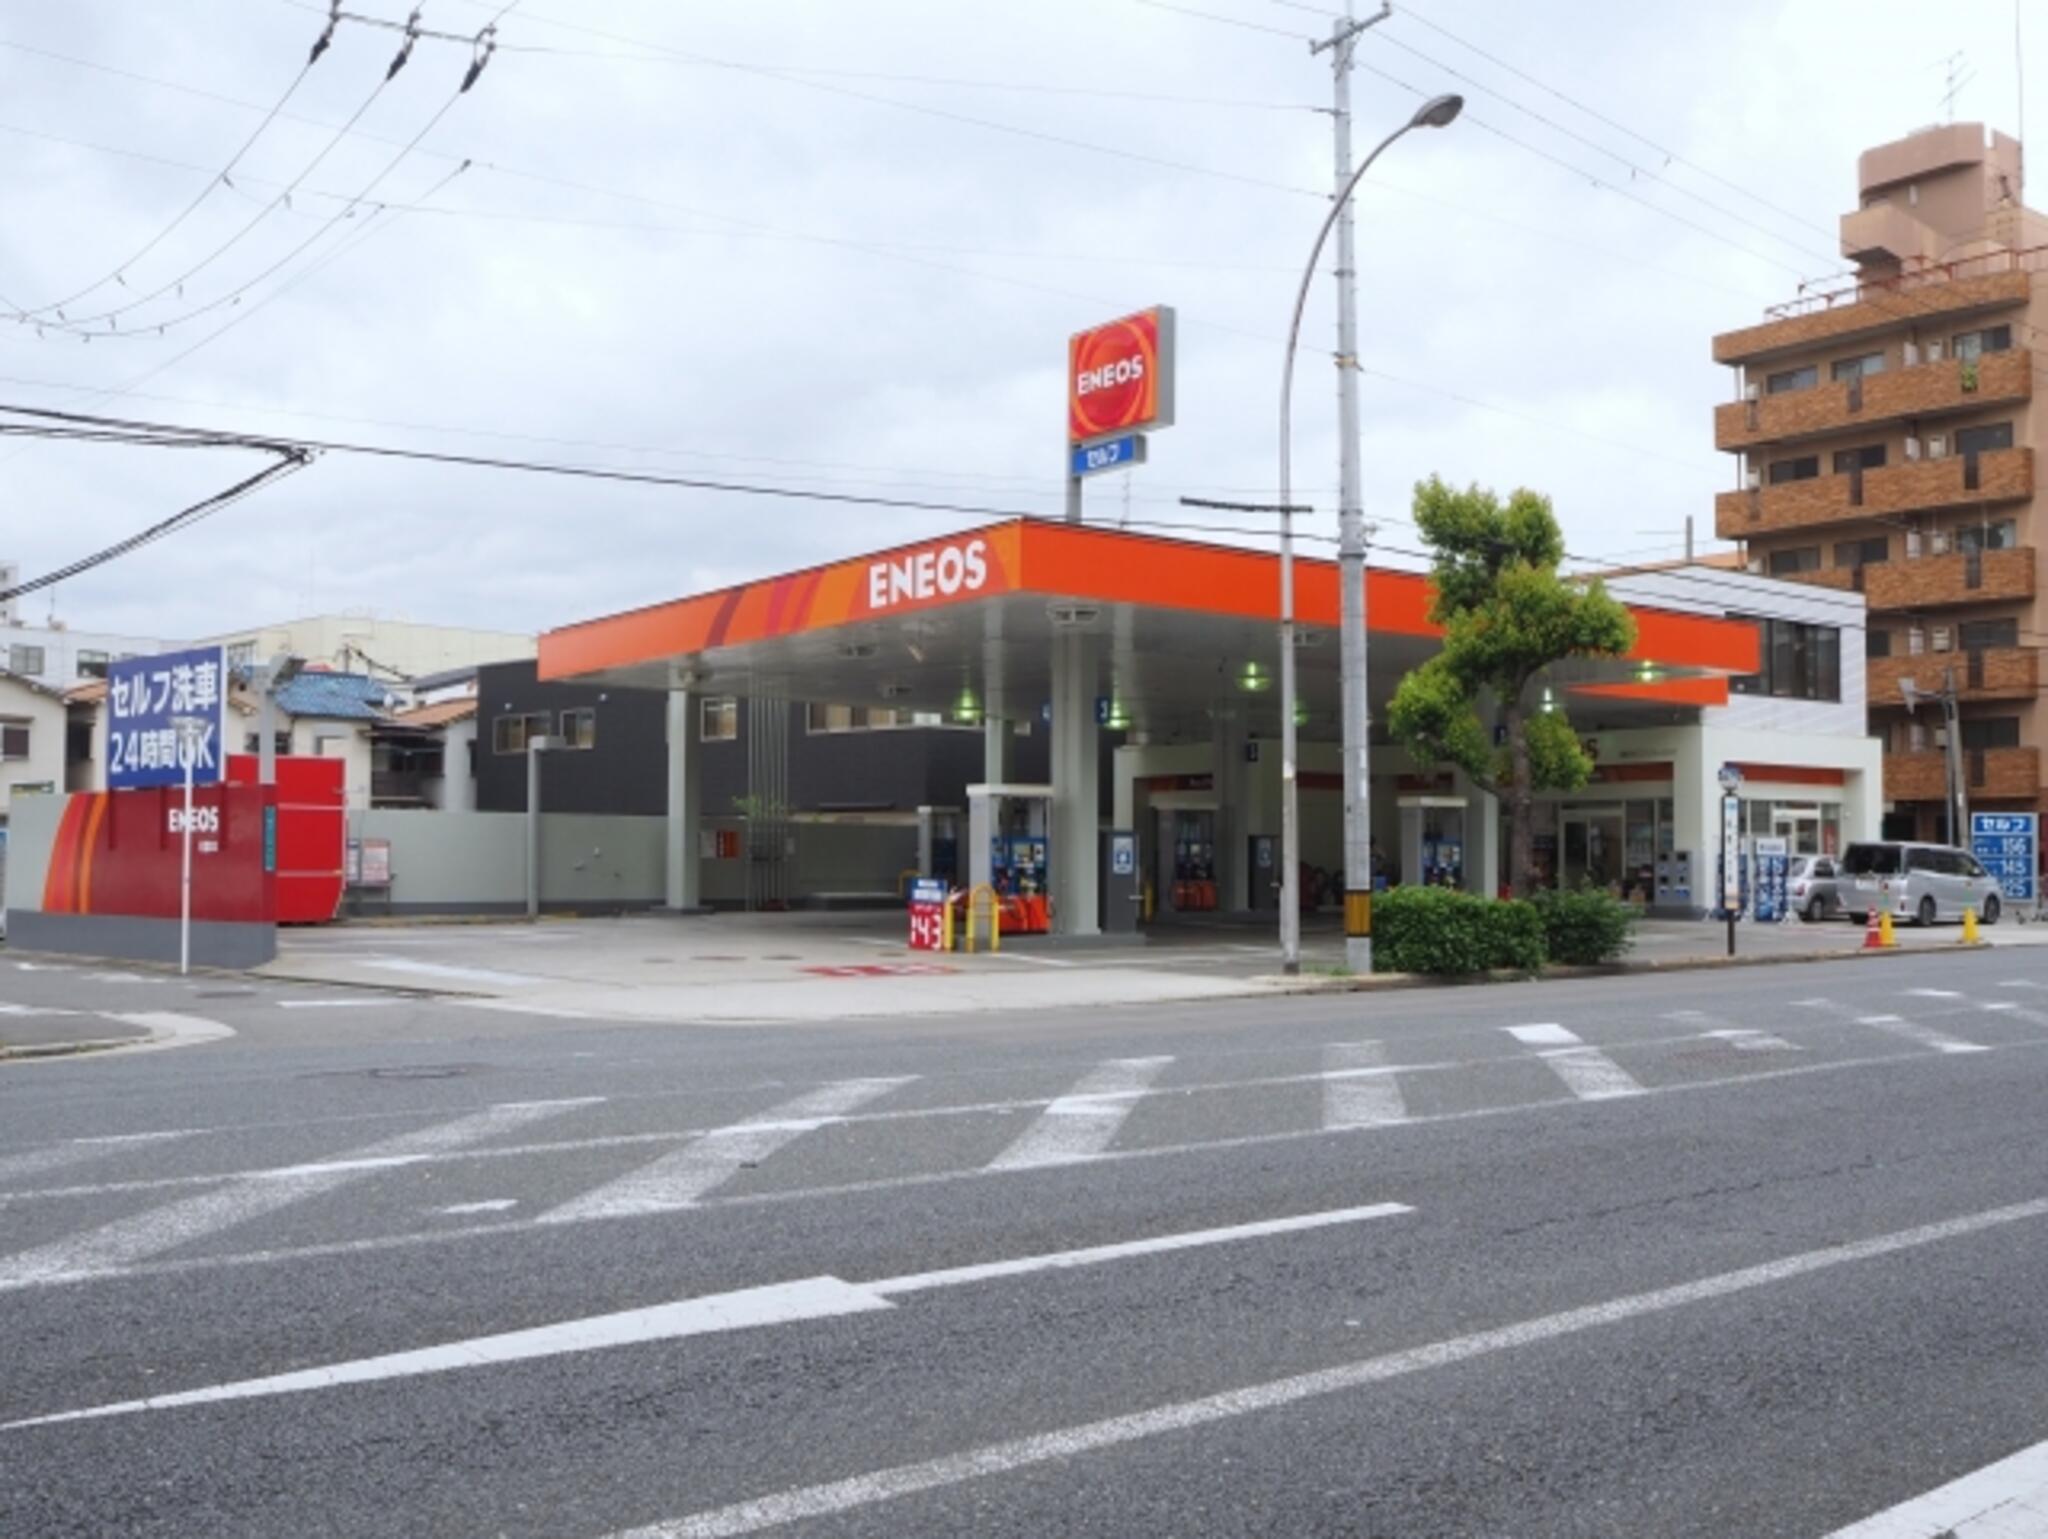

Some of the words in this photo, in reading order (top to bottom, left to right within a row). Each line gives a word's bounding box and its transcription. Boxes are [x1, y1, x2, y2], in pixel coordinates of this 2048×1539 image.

[1077, 353, 1144, 396] ENEOS
[868, 539, 987, 609] ENEOS
[111, 661, 218, 718] セルフ洗車
[1980, 818, 2026, 831] セルフ
[2000, 859, 2026, 875] 145
[911, 914, 942, 949] 143
